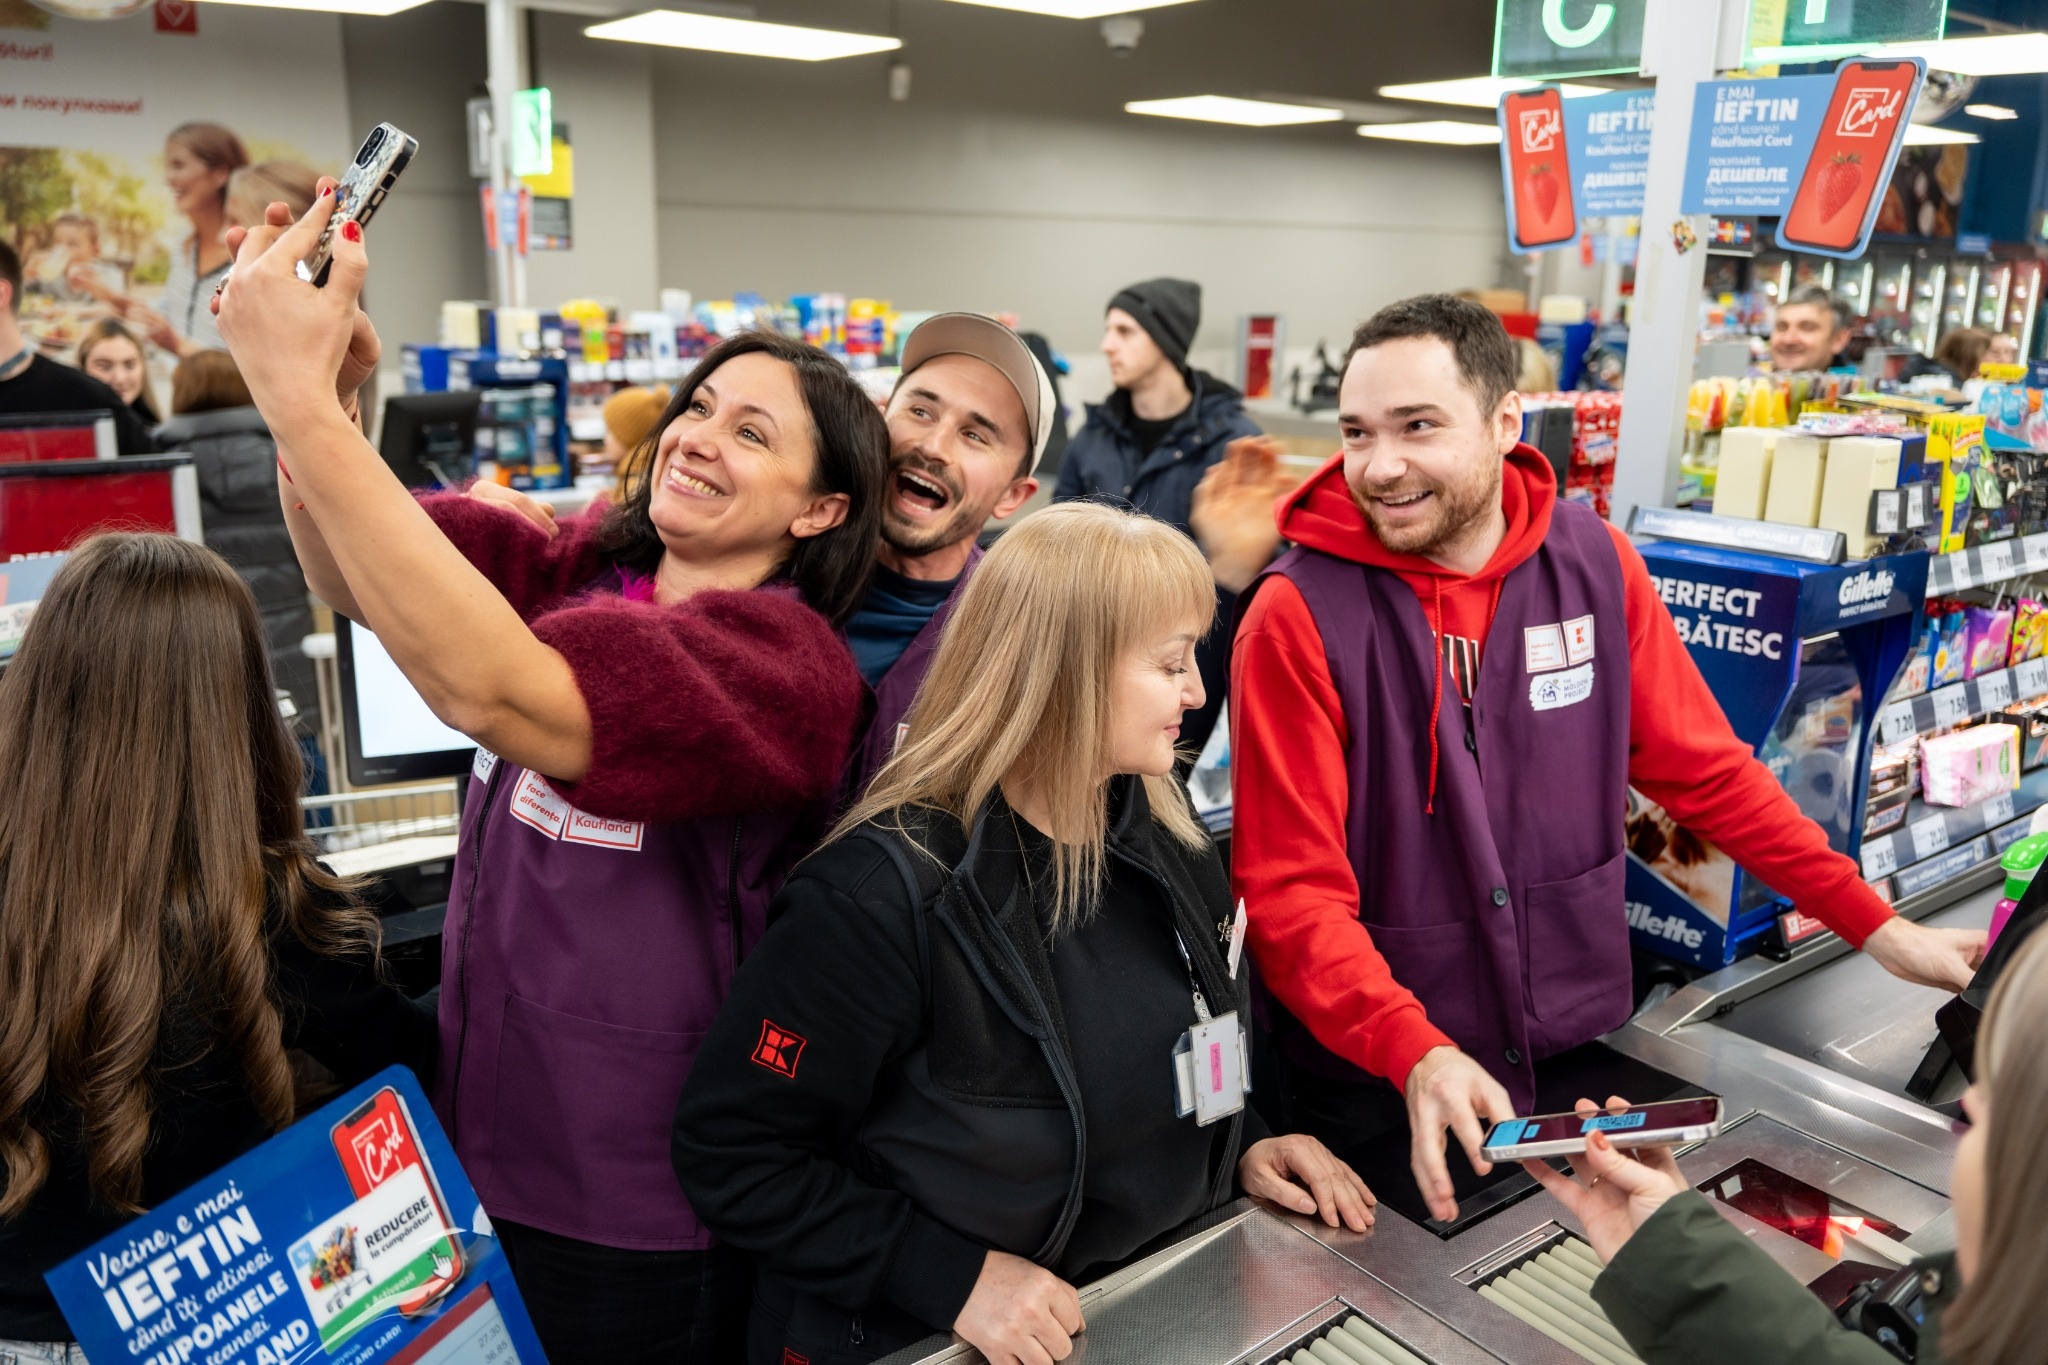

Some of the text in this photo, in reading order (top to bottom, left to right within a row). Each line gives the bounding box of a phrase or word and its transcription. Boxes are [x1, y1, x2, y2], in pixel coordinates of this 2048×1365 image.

[1638, 97, 1656, 109] MA
[1714, 98, 1798, 123] IEFTIN
[1717, 86, 1755, 100] E MAI
[1846, 89, 1902, 131] Card
[1710, 134, 1793, 148] Kaufland Card
[1582, 172, 1648, 190] ДЕШЕВЛ
[1707, 167, 1789, 185] ДЕШЕВЛЕ
[1839, 570, 1894, 605] Gillette
[1673, 613, 1783, 660] BĂTESC
[1895, 714, 1914, 735] 7.20
[526, 783, 546, 799] face
[575, 815, 632, 834] Kaufland
[1625, 901, 1703, 948] illette
[365, 1112, 404, 1183] Card
[86, 1179, 243, 1289] Vecine, e mai
[364, 1196, 430, 1249] REDUCERE
[370, 1210, 434, 1260] la cumpărături
[103, 1205, 262, 1333] IEFTIN
[127, 1308, 177, 1356] când
[205, 1246, 273, 1304] activezi
[206, 1314, 271, 1365] scanezi
[236, 1319, 309, 1365] AND
[375, 1325, 402, 1350] CARD!
